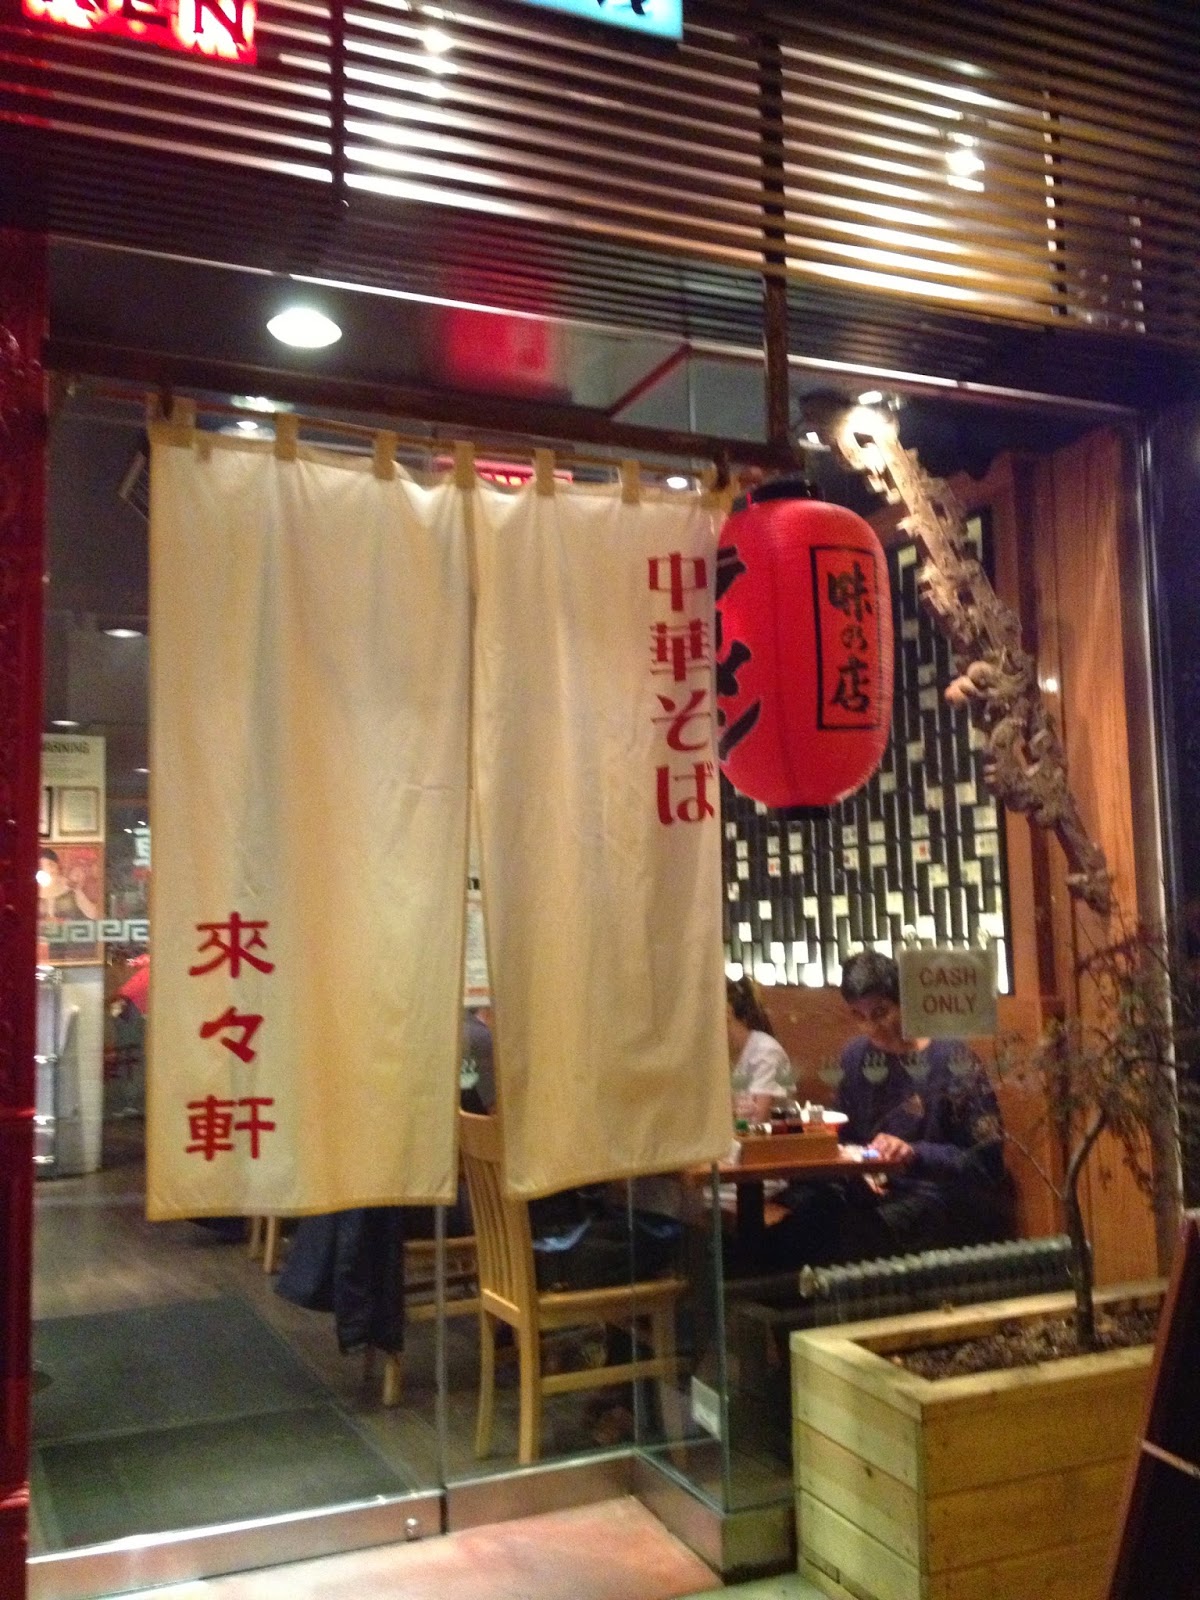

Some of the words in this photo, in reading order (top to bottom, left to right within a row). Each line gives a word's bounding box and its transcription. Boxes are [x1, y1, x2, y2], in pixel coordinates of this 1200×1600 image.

[648, 552, 714, 825] 中華そば
[919, 966, 977, 989] CASH
[923, 992, 977, 1016] ONLY
